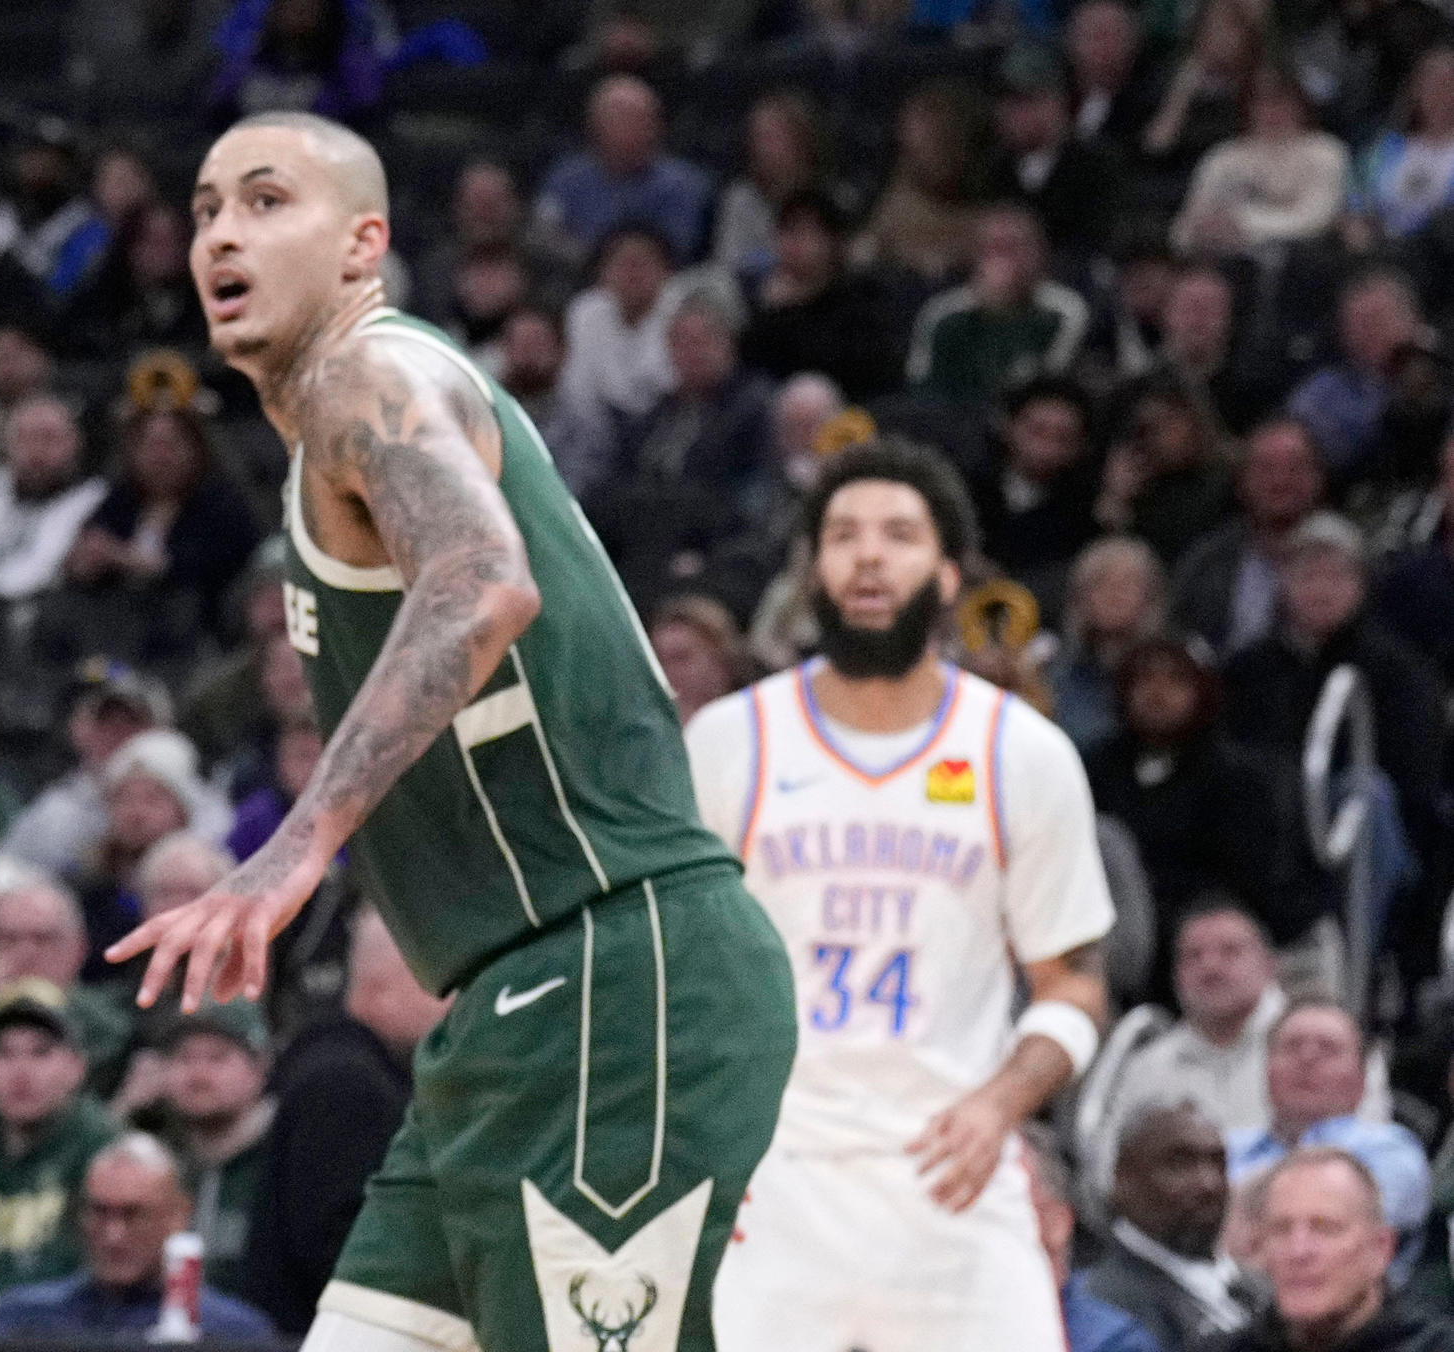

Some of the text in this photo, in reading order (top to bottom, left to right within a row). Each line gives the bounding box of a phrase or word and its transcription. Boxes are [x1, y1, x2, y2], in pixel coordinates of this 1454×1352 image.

[760, 821, 987, 885] OKLAHOMA
[819, 883, 920, 935] CITY
[809, 943, 921, 1038] 34
